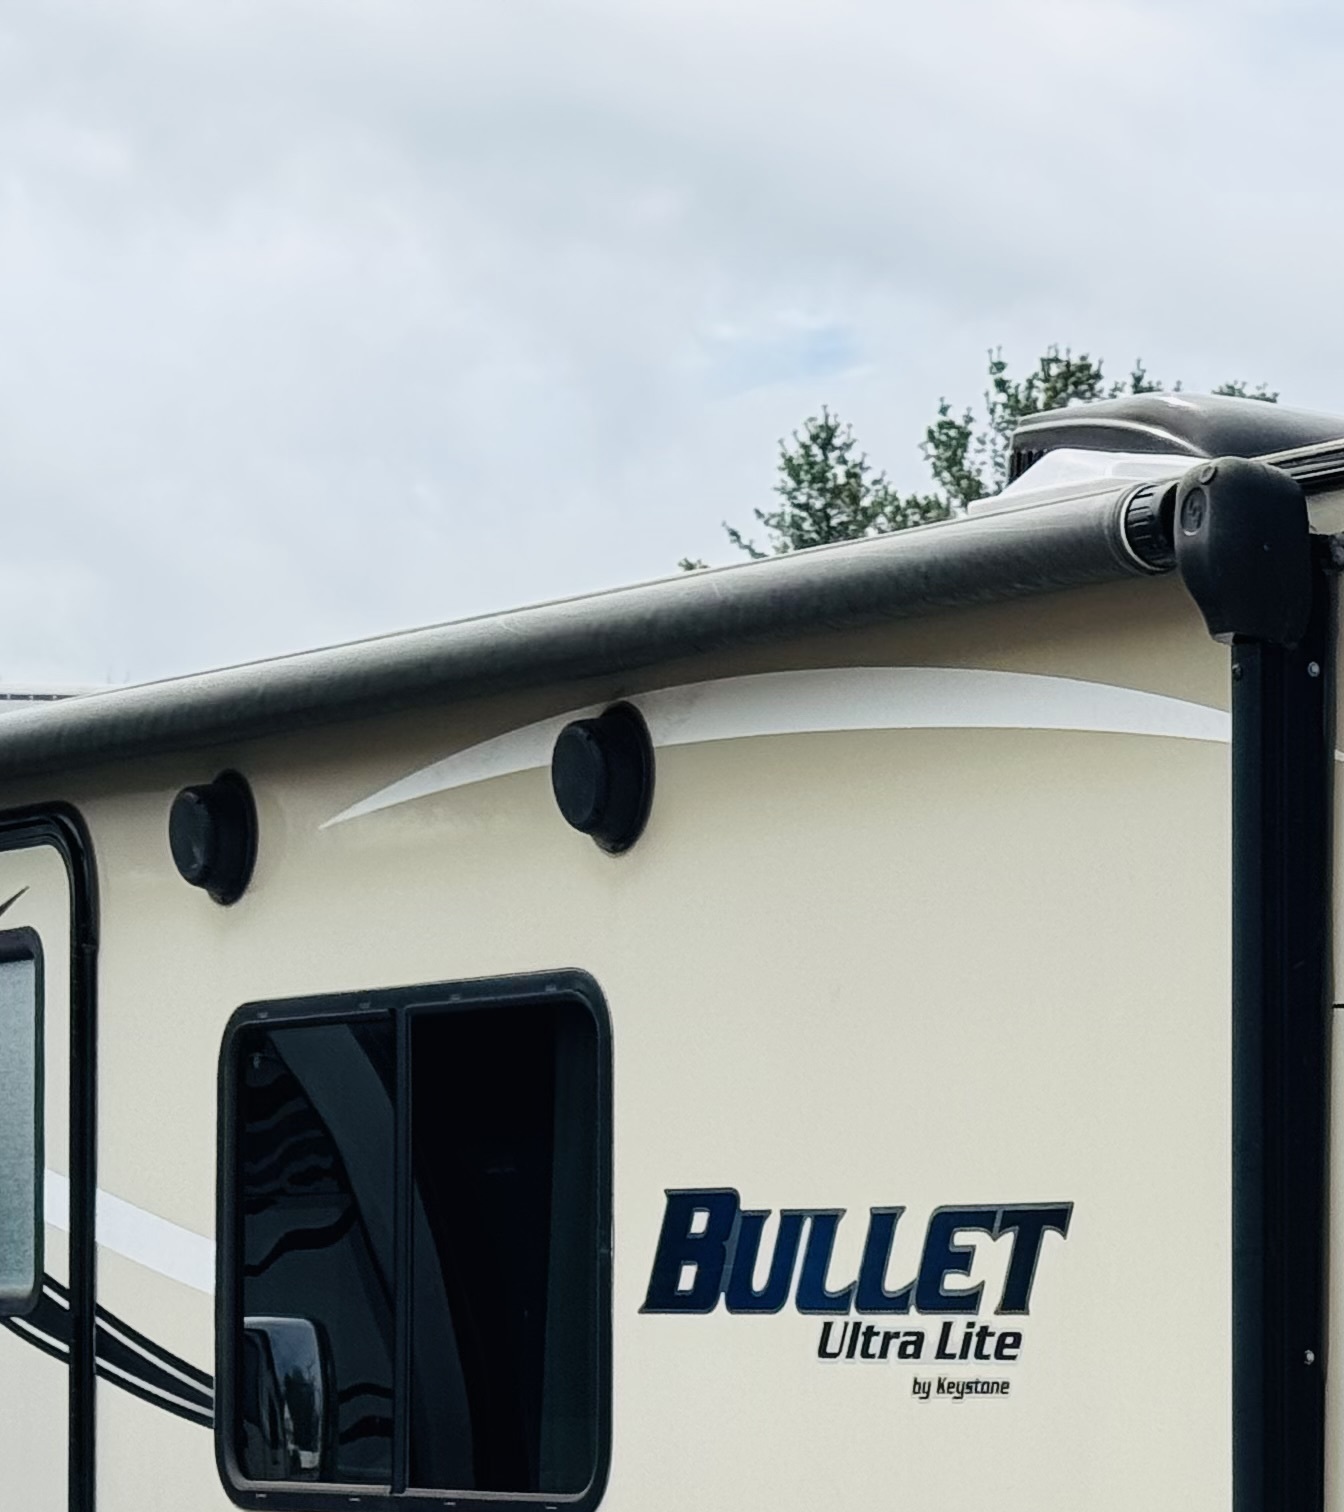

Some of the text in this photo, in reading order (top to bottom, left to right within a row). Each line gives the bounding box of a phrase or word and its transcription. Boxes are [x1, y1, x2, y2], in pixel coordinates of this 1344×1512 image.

[638, 1187, 1074, 1315] BULLET
[817, 1321, 1023, 1361] Ultra Lite
[912, 1376, 1010, 1400] by Keystone
